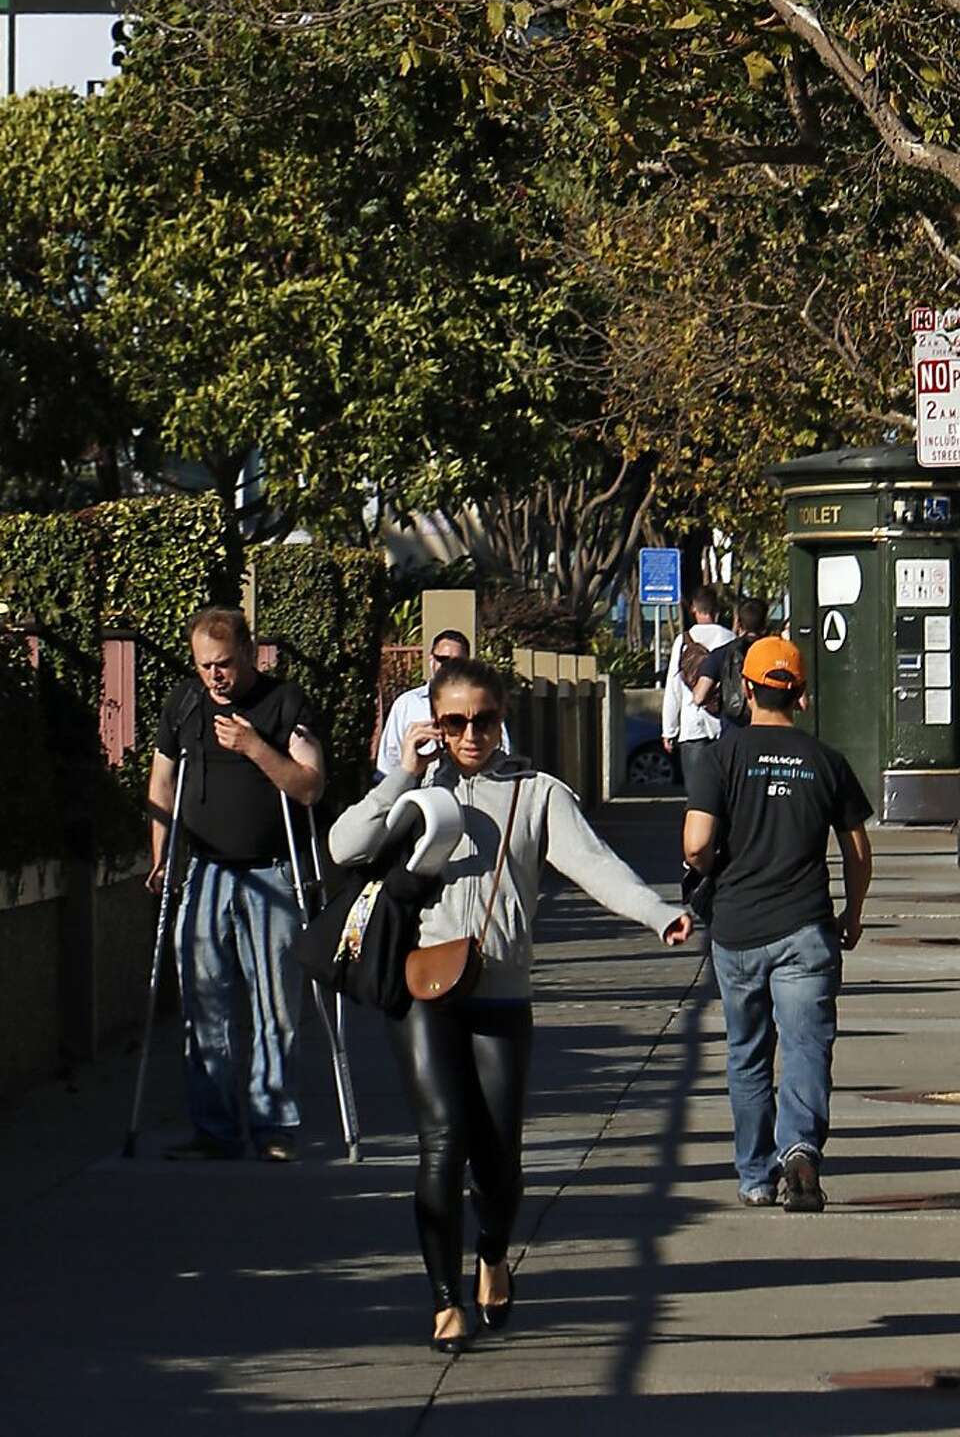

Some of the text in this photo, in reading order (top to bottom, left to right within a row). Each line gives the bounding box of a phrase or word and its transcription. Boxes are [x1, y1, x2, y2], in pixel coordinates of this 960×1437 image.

[921, 363, 948, 391] NO
[926, 400, 937, 419] 2
[799, 505, 842, 524] TOILET
